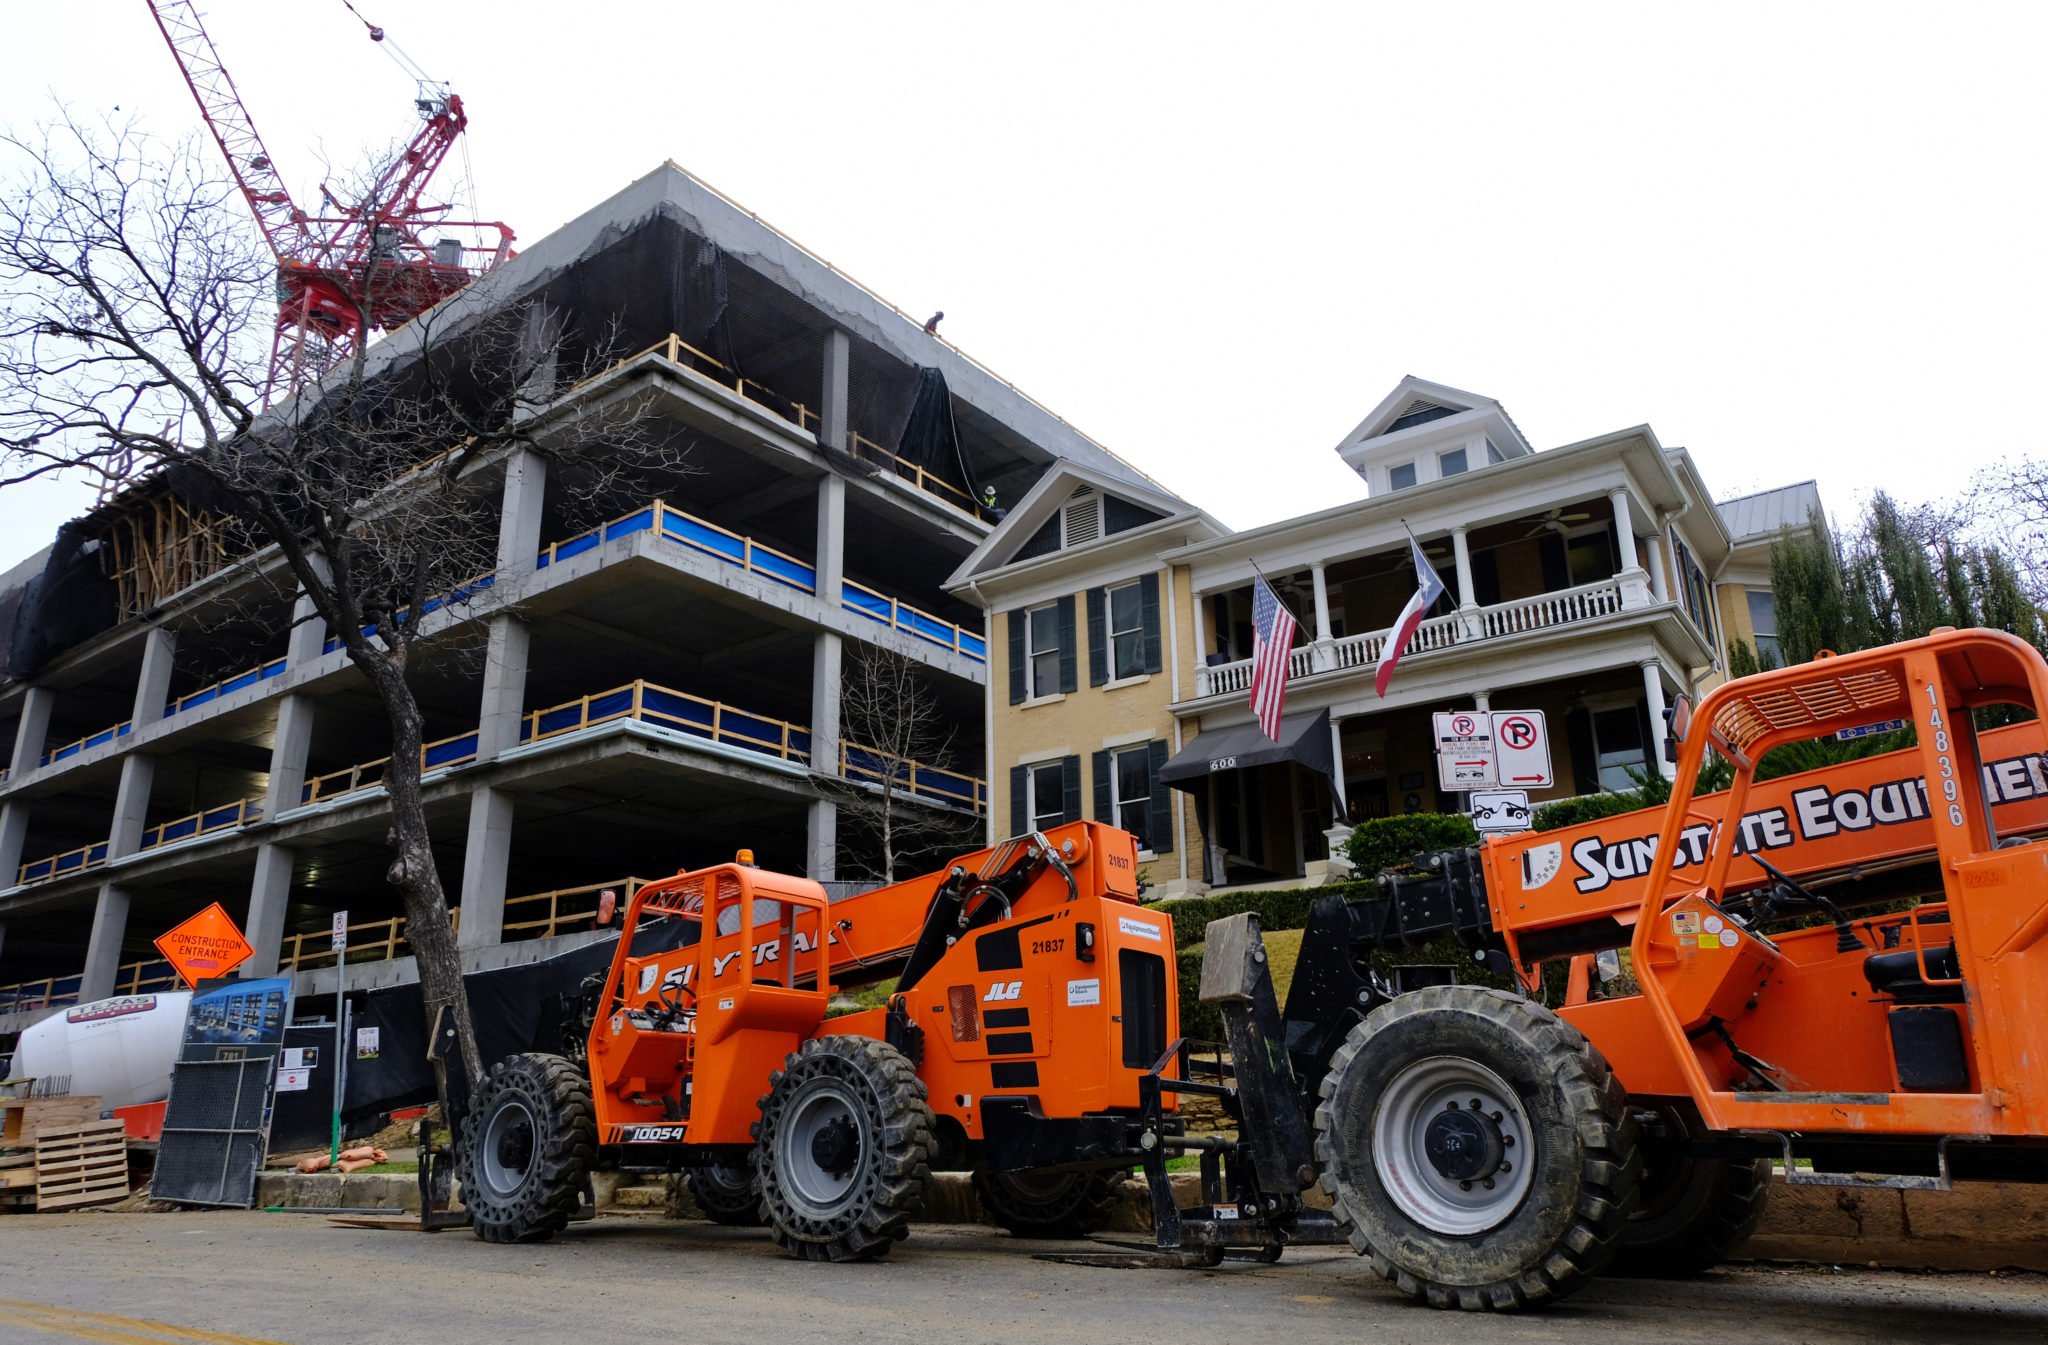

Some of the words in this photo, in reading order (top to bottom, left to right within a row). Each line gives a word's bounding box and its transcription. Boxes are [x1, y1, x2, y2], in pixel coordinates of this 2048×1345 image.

[1925, 684, 1964, 827] 148396
[1211, 757, 1235, 770] 600
[1573, 808, 1792, 892] SUNTTE
[1109, 854, 1128, 869] 21837
[171, 933, 242, 950] CONSTRUCTION
[1032, 939, 1064, 954] 21837
[178, 945, 229, 960] ENTRANCE
[983, 981, 1023, 1002] JLG
[78, 997, 149, 1013] TEXAS
[80, 1004, 144, 1019] CONCRETE
[633, 1127, 684, 1140] 10054
